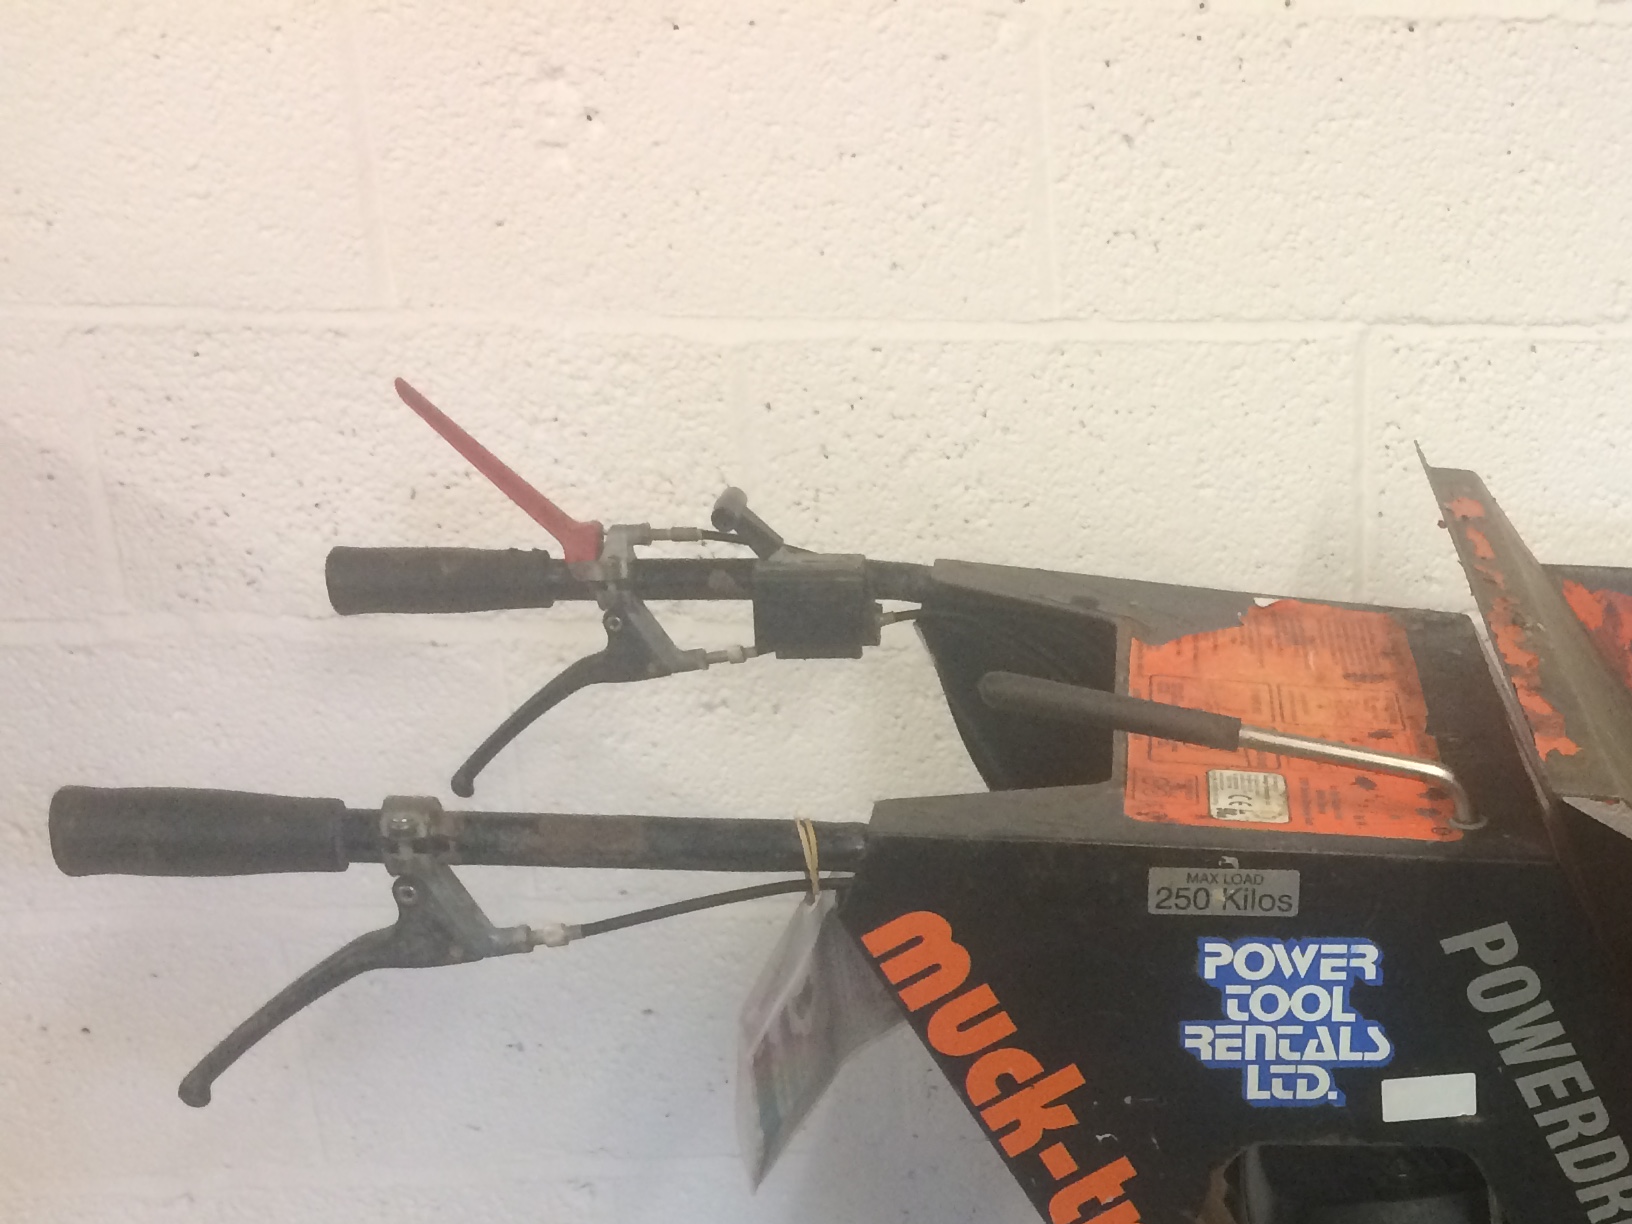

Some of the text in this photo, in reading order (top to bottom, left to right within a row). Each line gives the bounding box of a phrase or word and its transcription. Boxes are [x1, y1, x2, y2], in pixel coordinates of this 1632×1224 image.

[1186, 872, 1264, 886] MAX LOAD
[1155, 887, 1293, 912] 250 Kilos
[1203, 942, 1380, 980] POWER
[1225, 984, 1356, 1022] TOOL
[1184, 1025, 1392, 1061] RENTALS
[1246, 1064, 1338, 1100] LTD.
